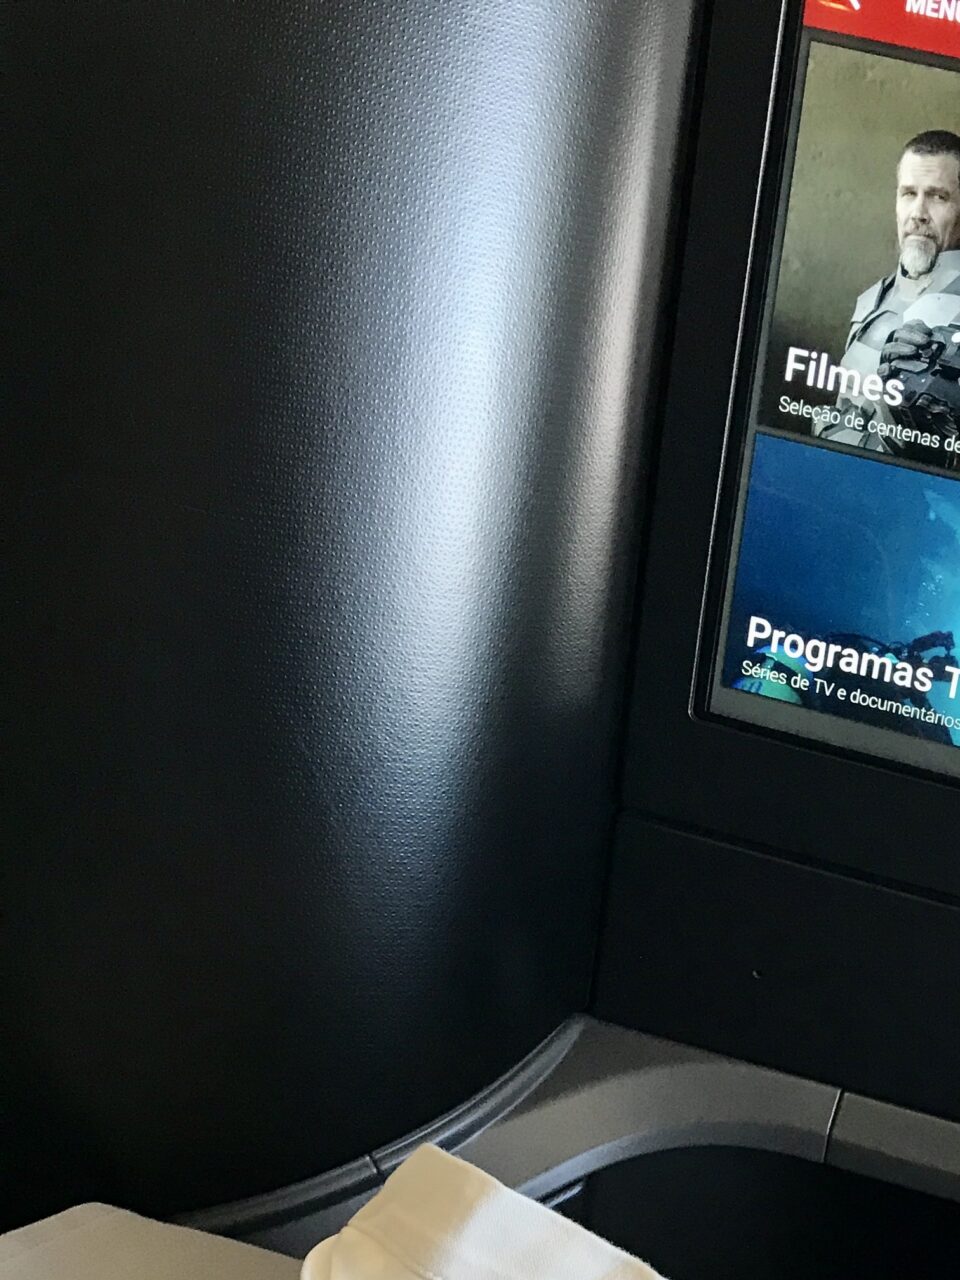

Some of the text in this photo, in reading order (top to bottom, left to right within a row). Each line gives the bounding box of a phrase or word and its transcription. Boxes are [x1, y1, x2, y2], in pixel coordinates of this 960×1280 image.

[784, 346, 905, 407] Filmes
[778, 395, 841, 425] Seleção
[845, 410, 864, 430] de
[867, 418, 941, 449] centenas
[741, 660, 788, 685] Séries
[790, 673, 810, 691] de
[813, 678, 835, 697] TV
[836, 687, 847, 700] e
[746, 615, 934, 692] Programas
